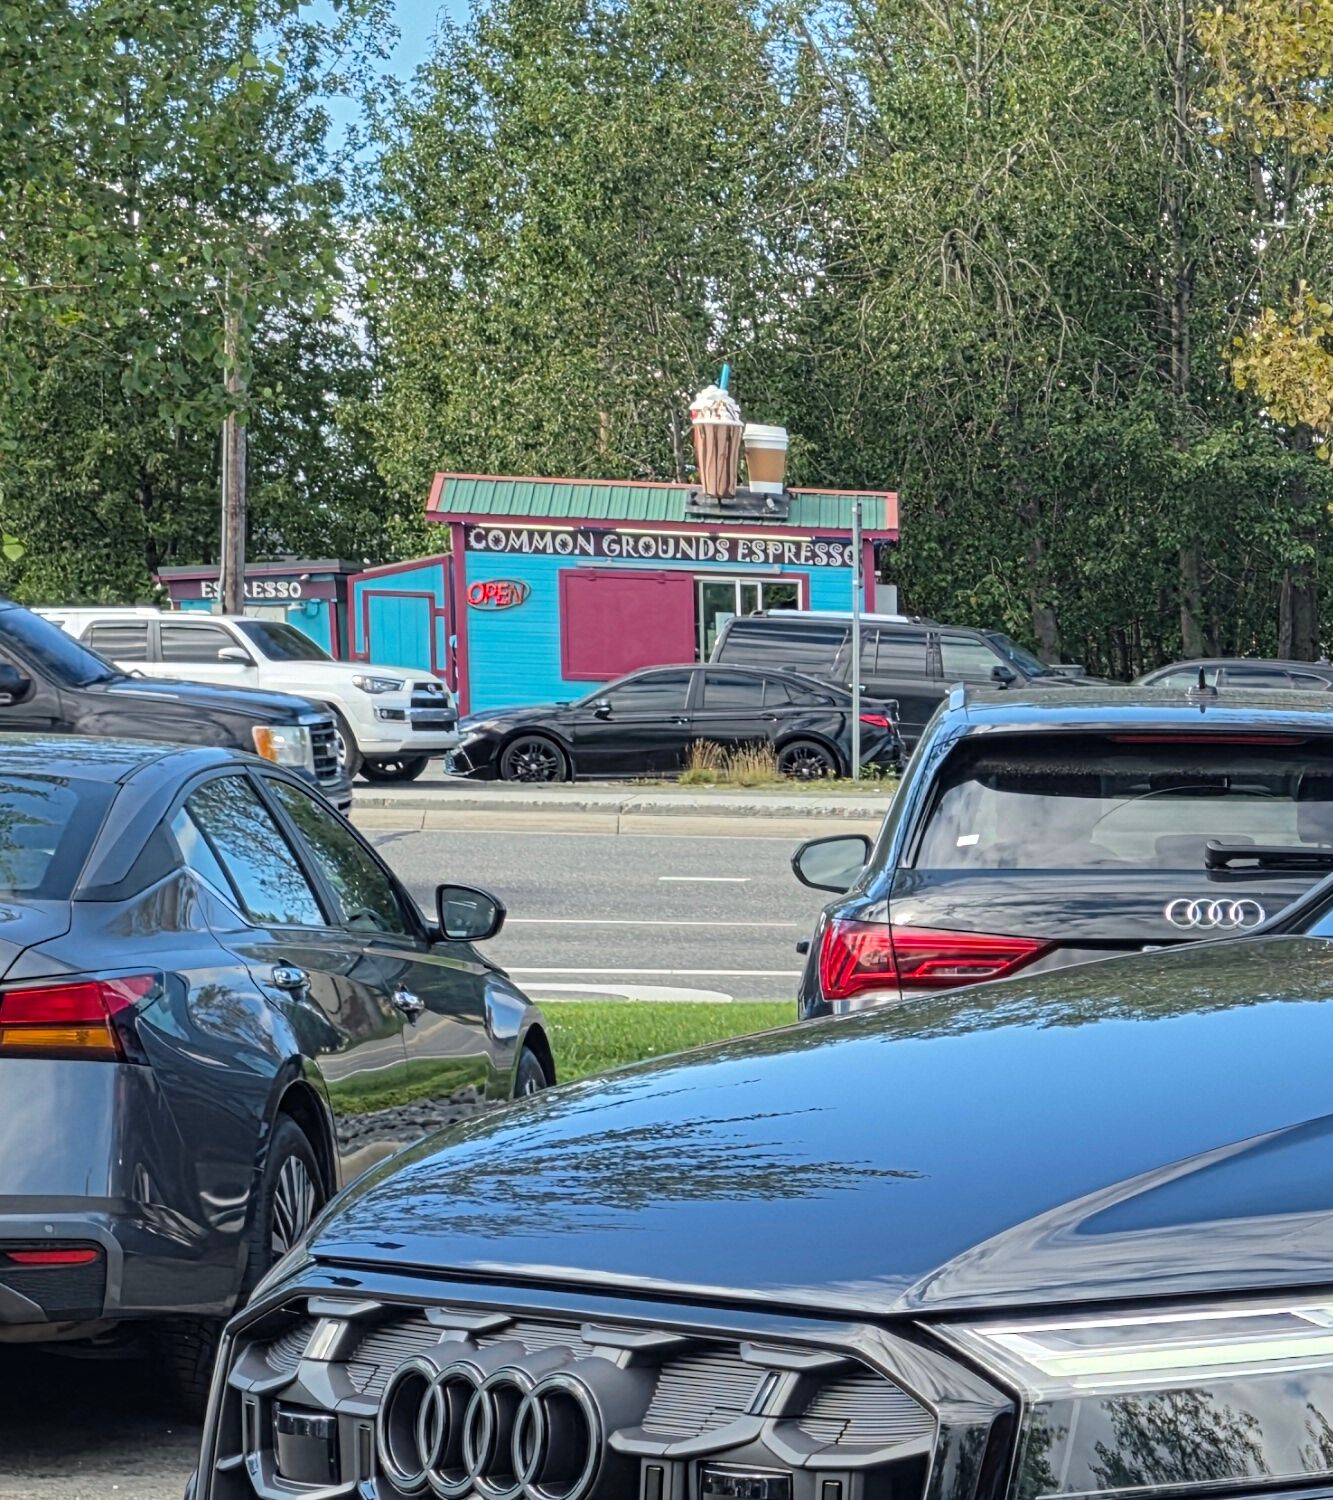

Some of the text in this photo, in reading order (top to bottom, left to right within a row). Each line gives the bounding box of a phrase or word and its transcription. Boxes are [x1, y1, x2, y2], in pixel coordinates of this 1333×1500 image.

[468, 527, 595, 556] COMMON
[602, 534, 730, 562] GROUNDS
[466, 581, 526, 607] OPEN
